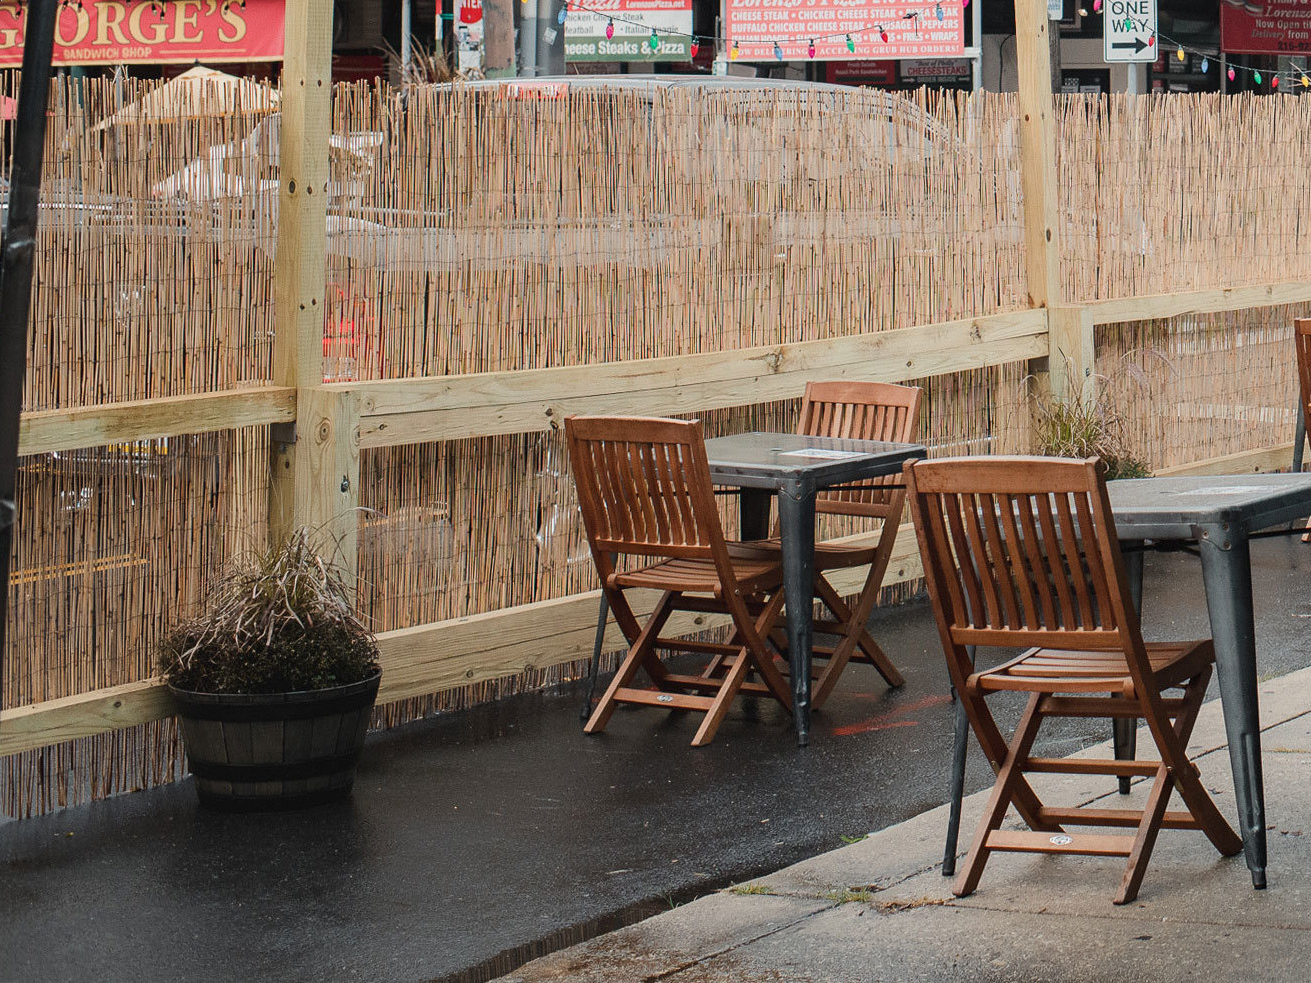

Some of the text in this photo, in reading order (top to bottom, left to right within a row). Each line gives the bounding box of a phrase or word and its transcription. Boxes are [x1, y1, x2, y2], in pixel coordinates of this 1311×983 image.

[1111, 0, 1149, 15] ONE
[565, 12, 591, 22] hicken
[622, 12, 644, 21] Steak
[731, 11, 762, 21] CHEESE
[764, 10, 789, 20] STEAK
[798, 9, 836, 20] CHICKEN
[838, 9, 869, 19] CHEESE
[870, 8, 897, 19] STEAK
[932, 7, 959, 17] SEAK
[565, 25, 594, 34] eatball
[731, 23, 768, 33] BUFFALO
[769, 22, 805, 32] CHICKEN
[807, 21, 838, 32] CHEESE
[840, 21, 865, 31] STEAK
[922, 19, 959, 29] PEPPERS
[1111, 18, 1149, 33] WAY
[1255, 19, 1274, 28] Now
[1277, 19, 1299, 31] Open
[827, 32, 862, 43] BURGRS
[870, 32, 896, 42] WIS
[930, 31, 959, 41] WRAPS
[1287, 30, 1309, 39] from
[63, 47, 153, 60] SANDWICH SHOP
[565, 42, 597, 55] heese
[598, 41, 638, 55] Steaks
[754, 47, 808, 57] DELIRING
[821, 46, 870, 56] ACCEPING
[872, 46, 897, 54] GRUB
[899, 45, 919, 54] HUB
[906, 66, 967, 76] CHEESESTEAKS
